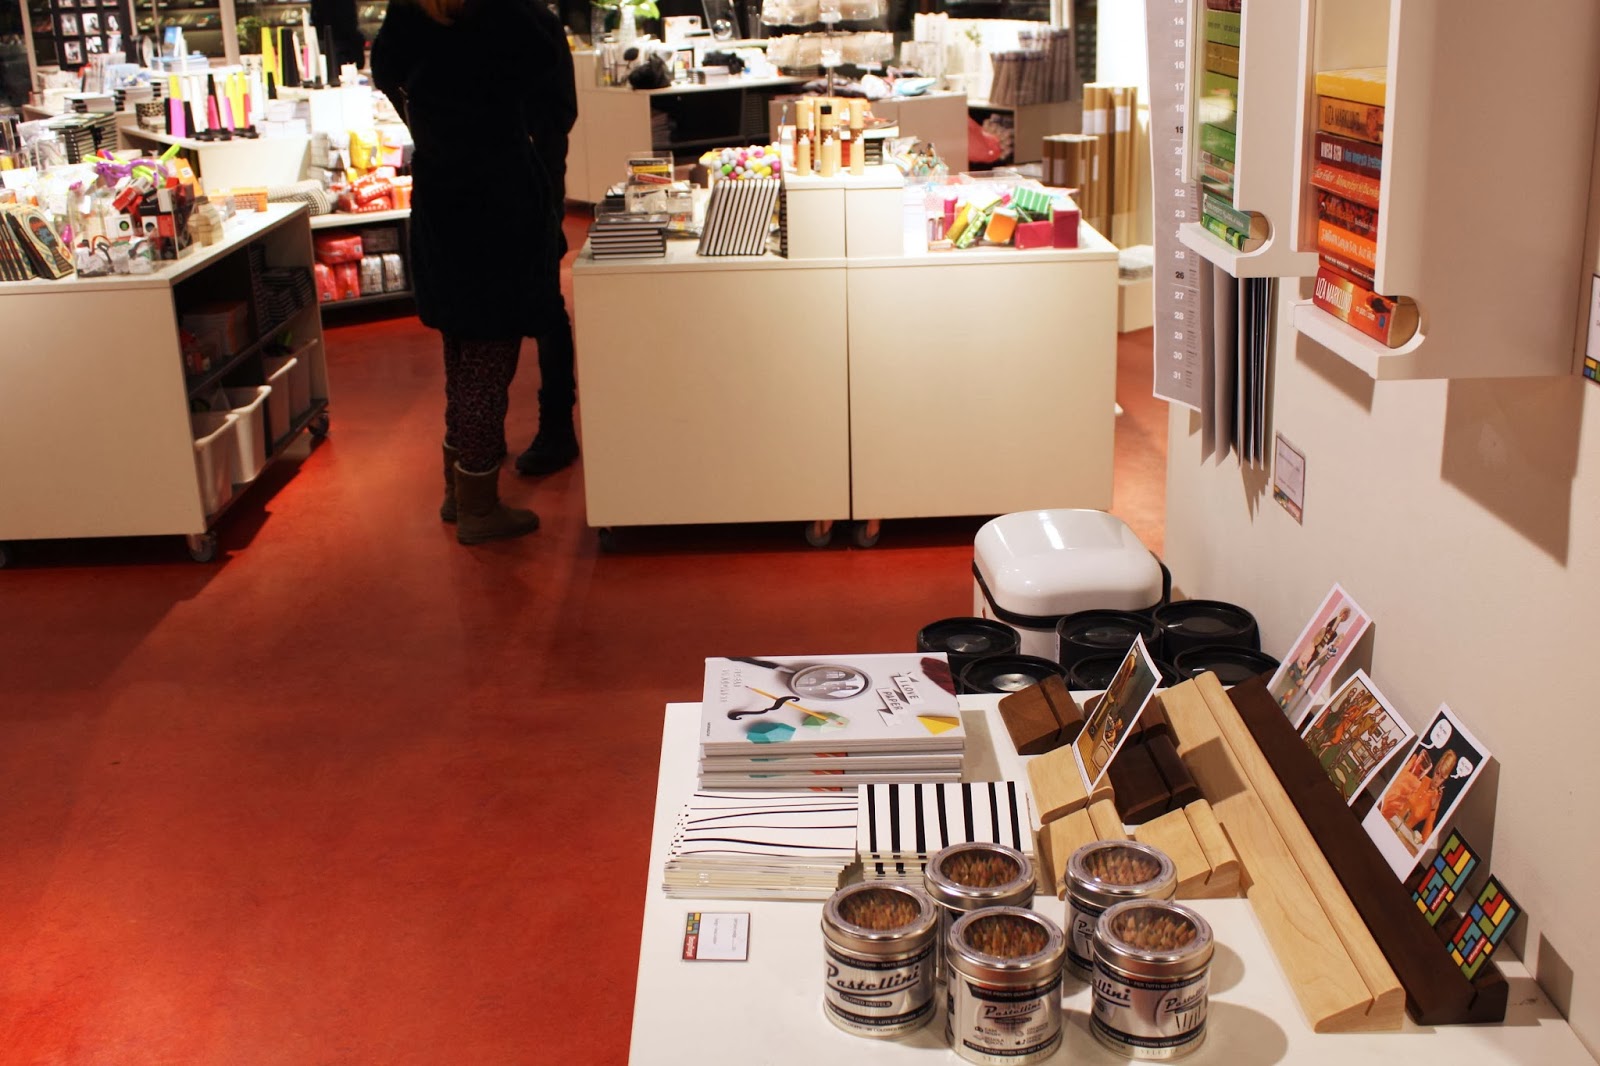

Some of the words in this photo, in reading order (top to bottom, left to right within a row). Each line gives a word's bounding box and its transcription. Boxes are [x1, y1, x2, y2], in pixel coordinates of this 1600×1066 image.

[1174, 17, 1184, 26] 14
[1174, 39, 1184, 48] 15
[1174, 61, 1185, 69] 16
[1174, 83, 1185, 91] 17
[1174, 189, 1185, 197] 22
[1175, 210, 1185, 218] 23
[1175, 251, 1185, 259] 25
[1175, 271, 1184, 280] 26
[1174, 291, 1184, 300] 27
[1315, 277, 1327, 299] LIZA
[1325, 282, 1353, 314] MARKLUND
[1174, 311, 1184, 320] 28
[1174, 331, 1183, 340] 29
[1173, 351, 1182, 360] 30
[1173, 371, 1181, 379] 31
[901, 684, 919, 699] LOVE
[882, 691, 904, 711] PAPER
[826, 960, 920, 991] Pastellini
[984, 999, 1042, 1016] Pastellini
